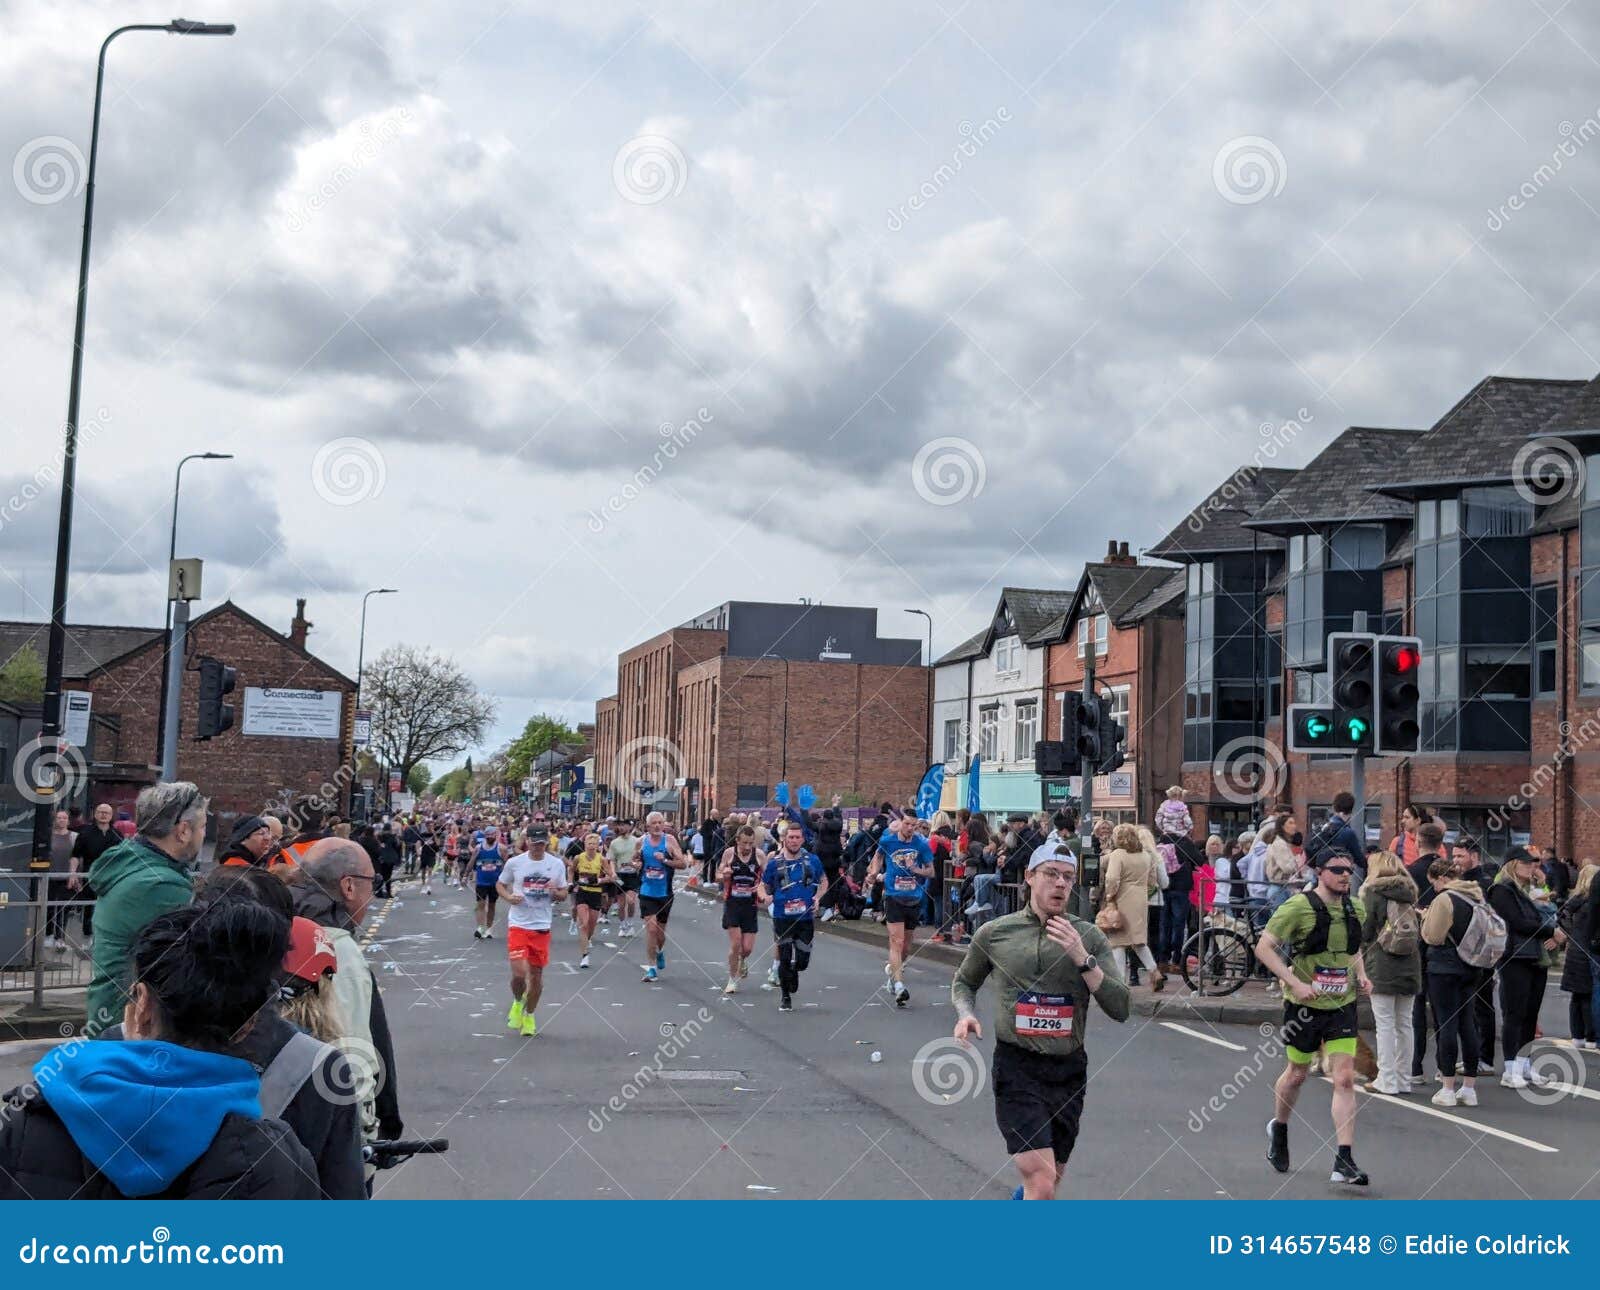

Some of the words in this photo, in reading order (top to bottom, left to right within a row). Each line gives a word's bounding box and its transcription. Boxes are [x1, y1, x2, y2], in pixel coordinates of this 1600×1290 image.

[263, 689, 324, 700] Connections
[1034, 1008, 1058, 1016] ADAM
[1028, 1018, 1062, 1029] 12296
